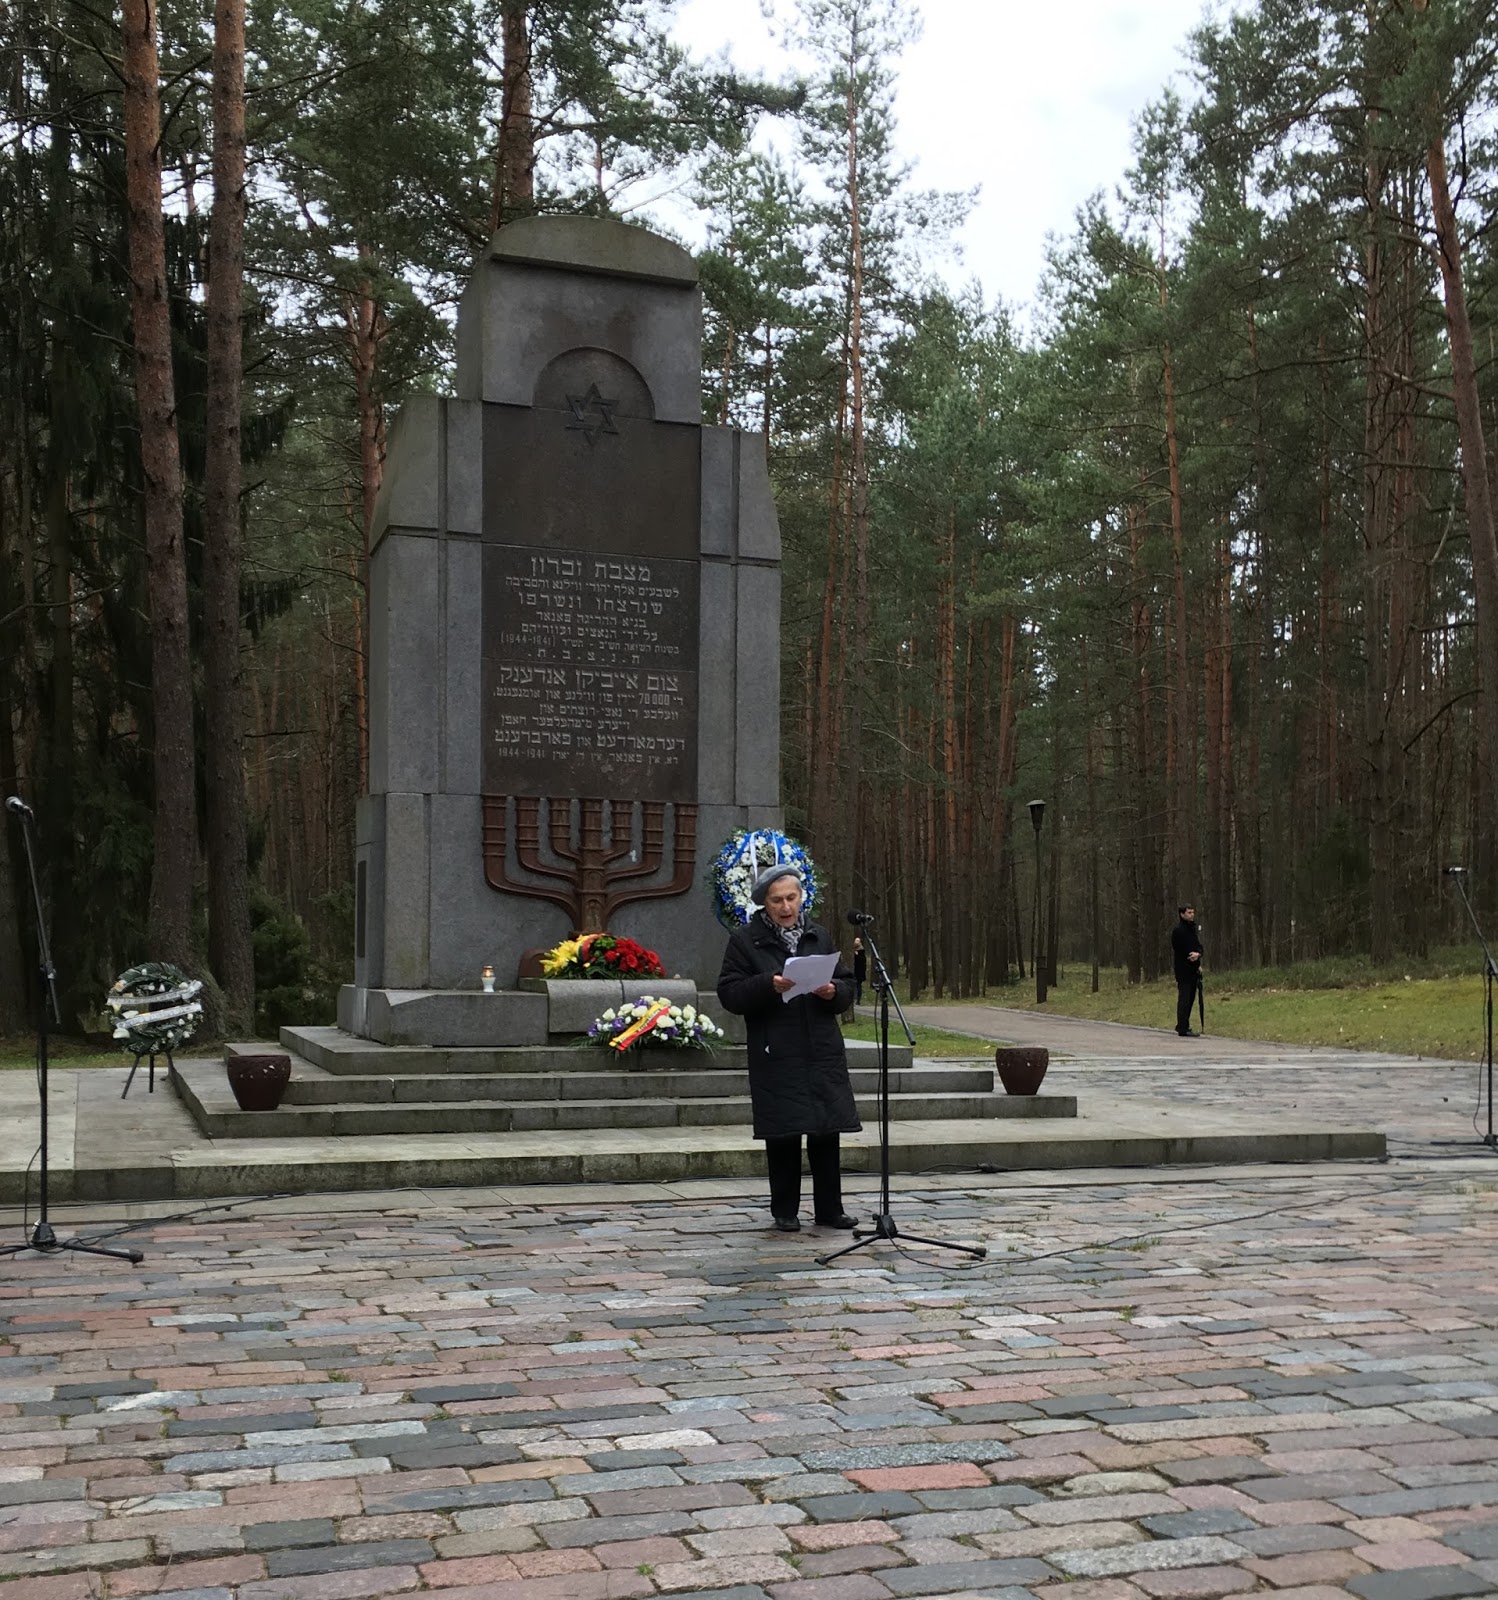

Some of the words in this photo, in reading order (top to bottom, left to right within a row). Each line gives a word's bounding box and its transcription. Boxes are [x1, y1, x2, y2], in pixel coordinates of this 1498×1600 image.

[530, 556, 583, 577] זכרון
[594, 561, 651, 582] מצבת
[505, 576, 550, 588] והסביבה
[552, 579, 582, 591] ווילנא
[585, 582, 611, 593] יהודי
[613, 583, 635, 597] אלף
[638, 586, 680, 599] לשבעים
[518, 591, 582, 609] ונשרפו
[595, 597, 663, 615] שנרצחו
[577, 613, 617, 626] ההריגה
[622, 617, 647, 628] בגיא
[521, 622, 572, 635] ועוזריהם
[577, 626, 617, 639] הנאצים
[622, 630, 638, 640] ידי
[643, 629, 659, 642] על
[654, 644, 680, 654] בשנות
[500, 665, 566, 685] אנדענק
[575, 668, 638, 690] אייביקן
[647, 674, 679, 692] צום
[545, 689, 561, 701] און
[564, 689, 595, 701] ווילנע
[598, 692, 613, 705] פון
[673, 696, 684, 706] די
[627, 708, 639, 718] די
[494, 729, 571, 745] פארברענט
[596, 732, 685, 751] דערמארדעט
